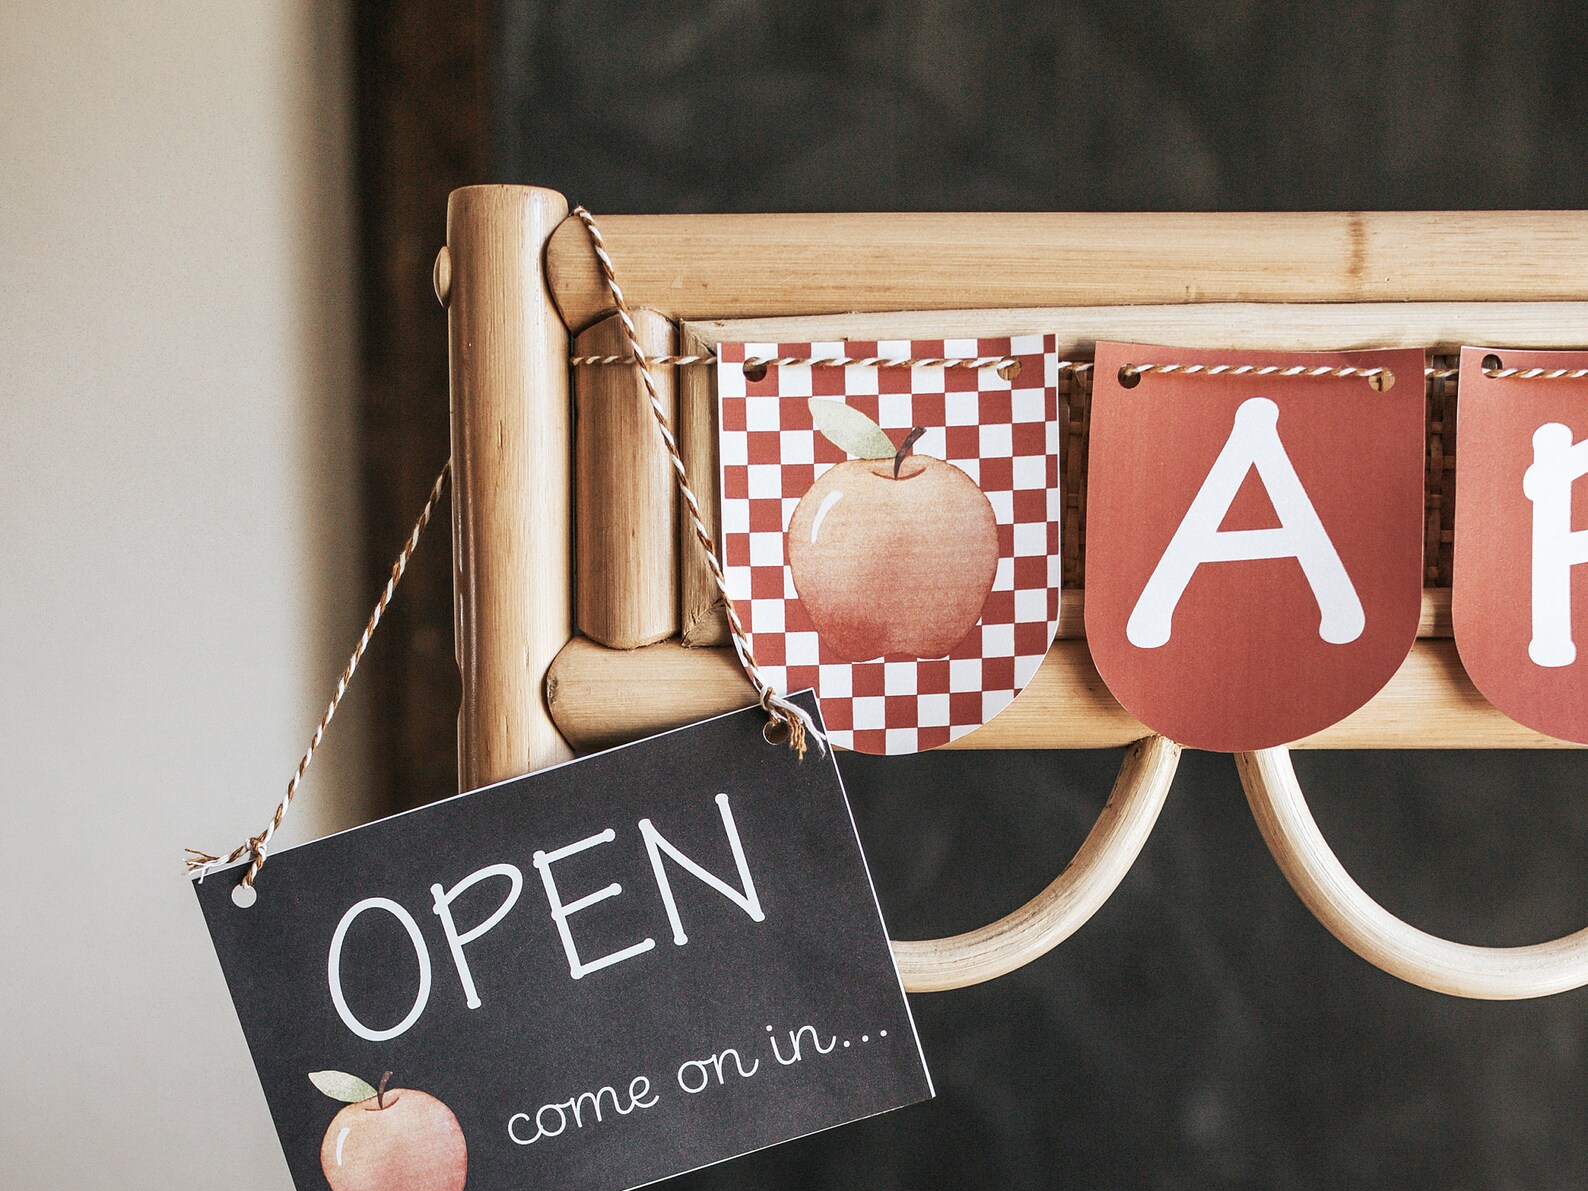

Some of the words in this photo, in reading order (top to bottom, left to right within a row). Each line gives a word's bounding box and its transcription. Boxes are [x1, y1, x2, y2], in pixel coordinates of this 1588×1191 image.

[327, 792, 766, 1042] OPEN
[507, 1075, 660, 1145] come
[677, 1048, 760, 1094] on
[765, 1024, 888, 1065] in...
